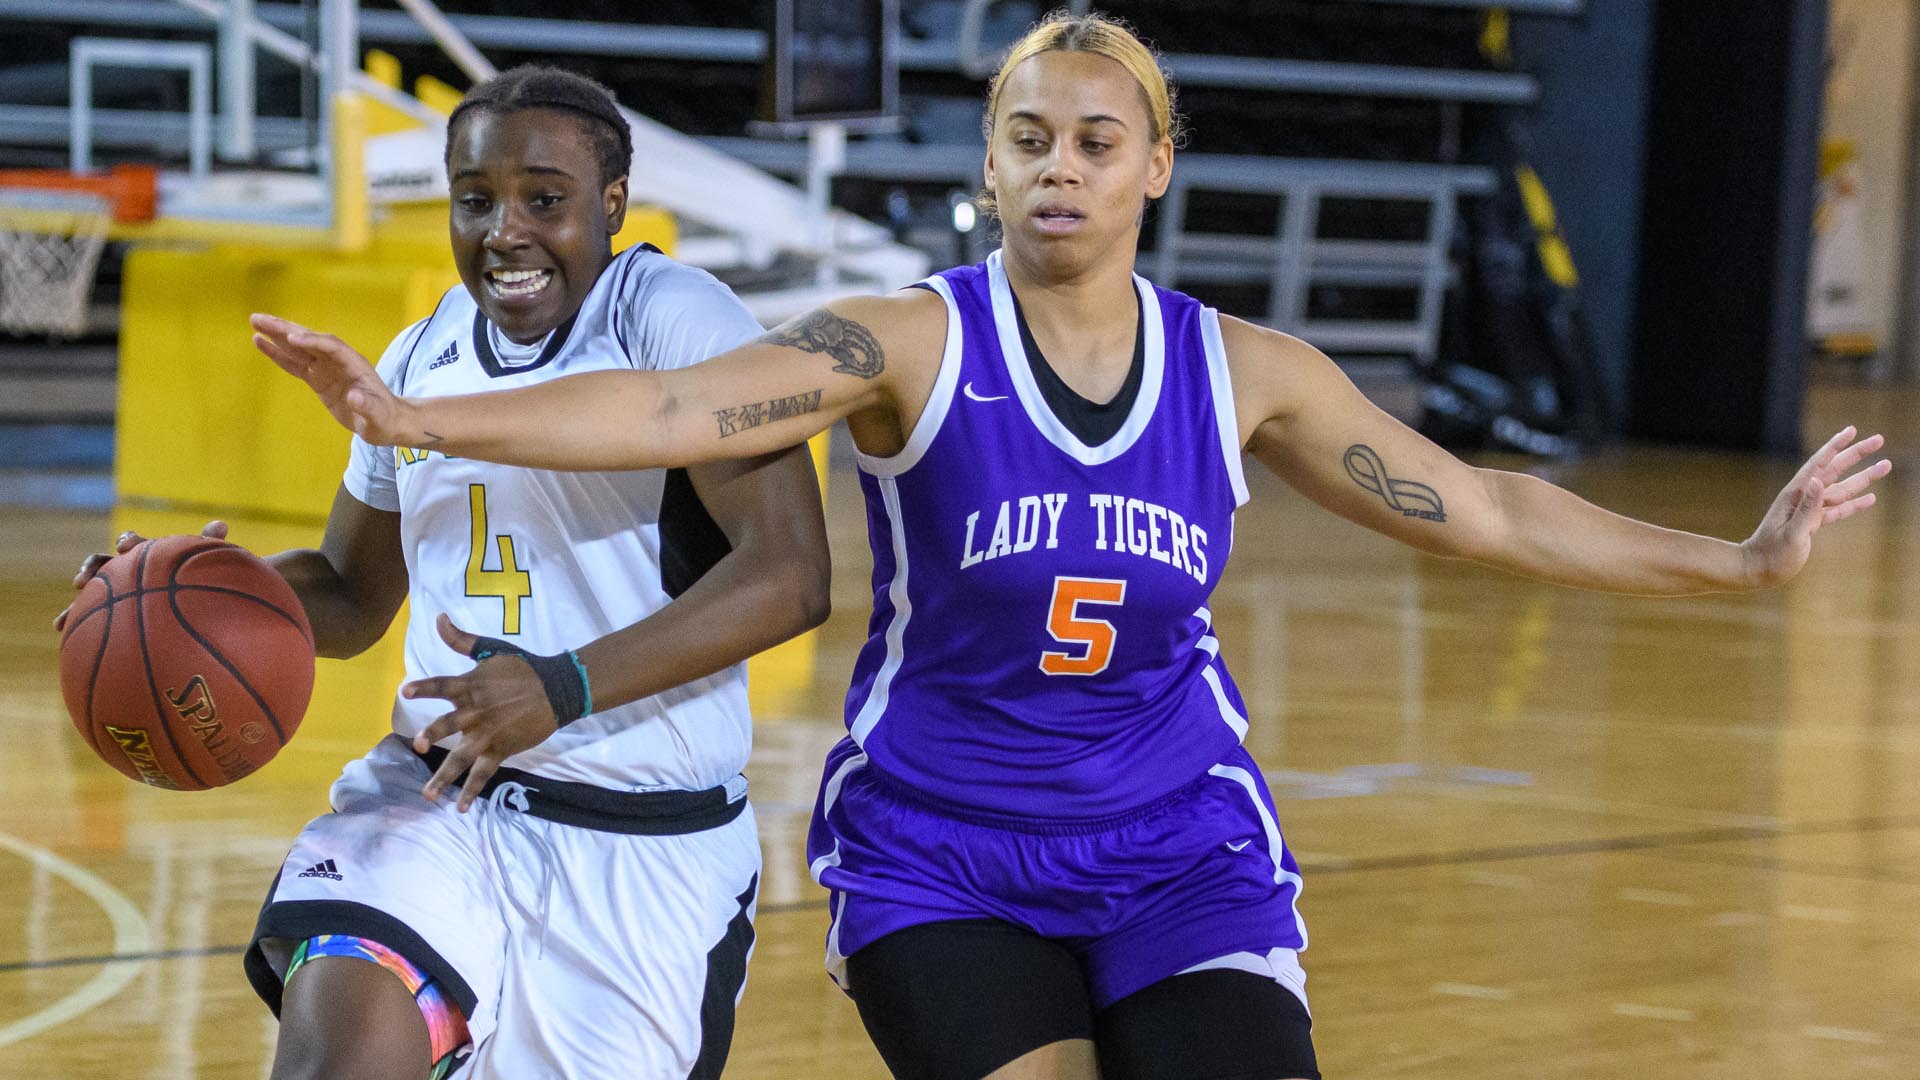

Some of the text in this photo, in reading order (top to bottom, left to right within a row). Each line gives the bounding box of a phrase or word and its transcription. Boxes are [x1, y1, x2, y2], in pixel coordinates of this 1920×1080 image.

[429, 354, 460, 370] adidas
[464, 484, 532, 635] 4
[960, 493, 1208, 585] LADY TIGERS
[1038, 576, 1127, 676] 5
[297, 869, 344, 882] adidas
